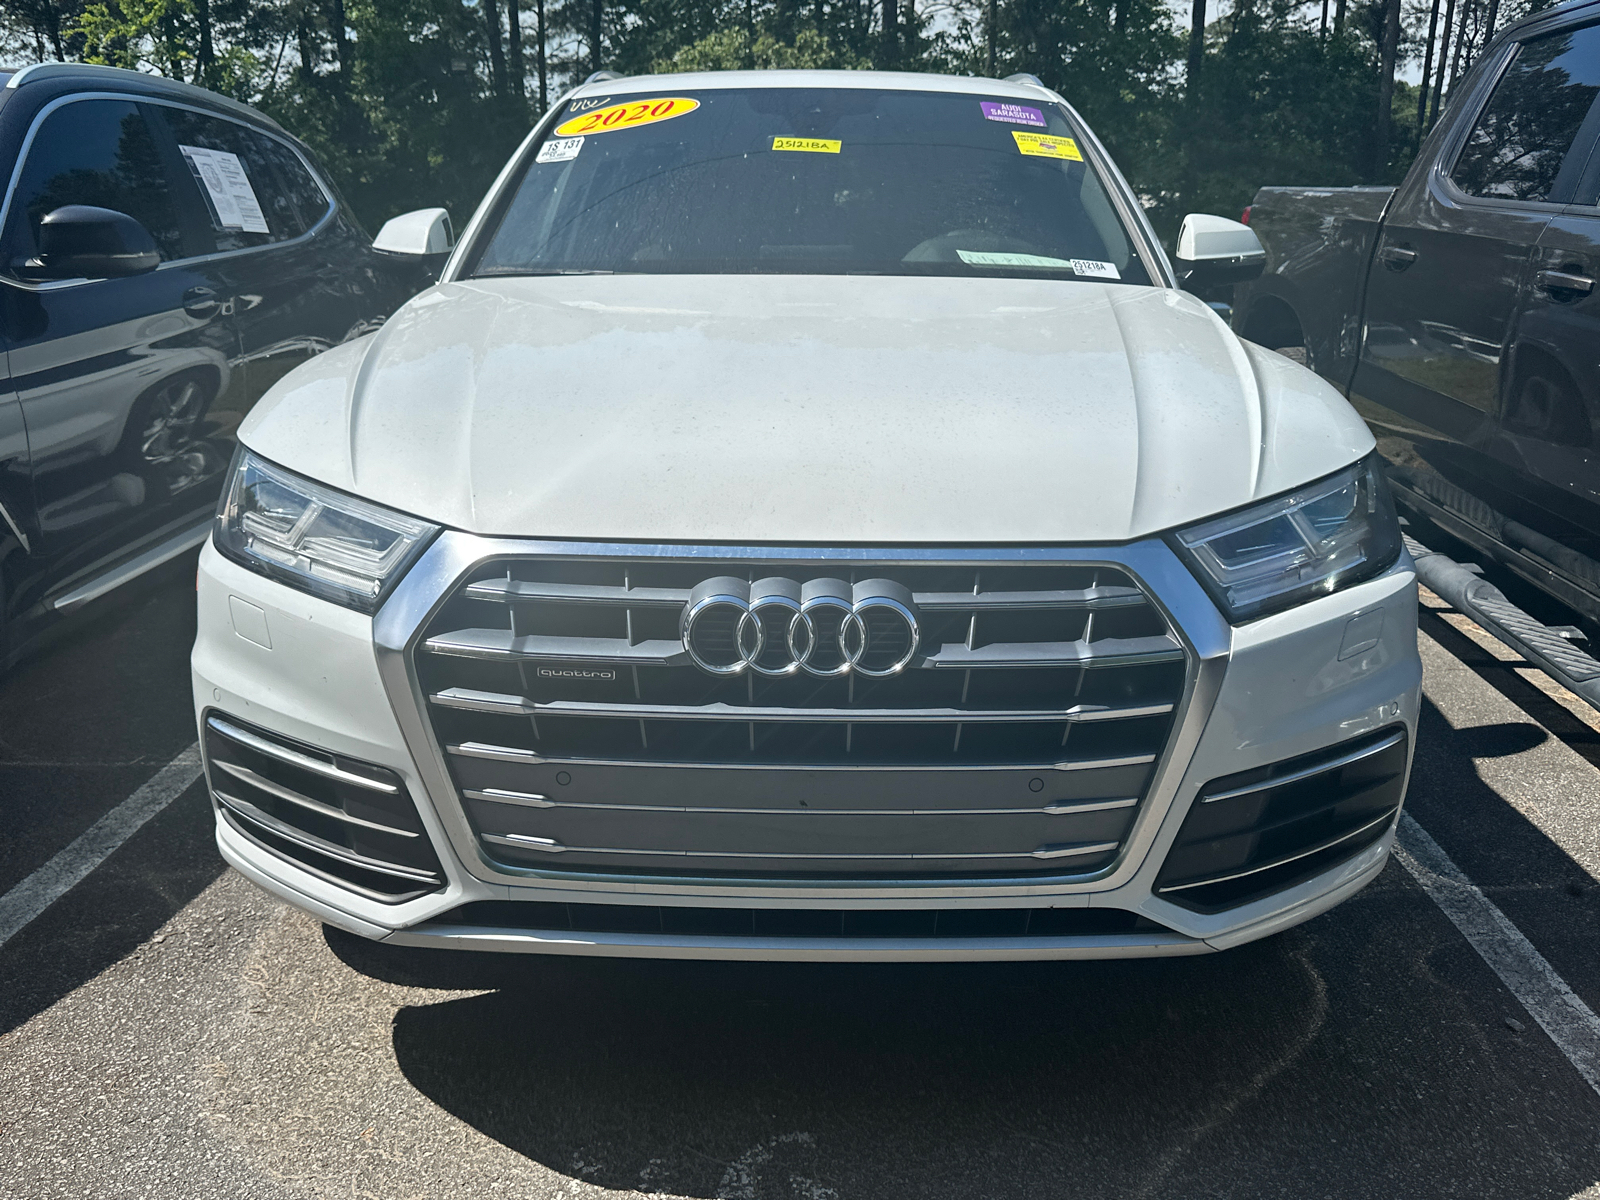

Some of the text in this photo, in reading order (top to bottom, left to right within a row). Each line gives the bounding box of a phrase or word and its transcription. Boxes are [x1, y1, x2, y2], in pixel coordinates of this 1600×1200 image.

[1001, 103, 1022, 112] AUDI
[577, 101, 675, 133] 2020
[990, 108, 1037, 120] SARASOTA
[563, 139, 581, 150] 131
[540, 669, 612, 678] quattro
